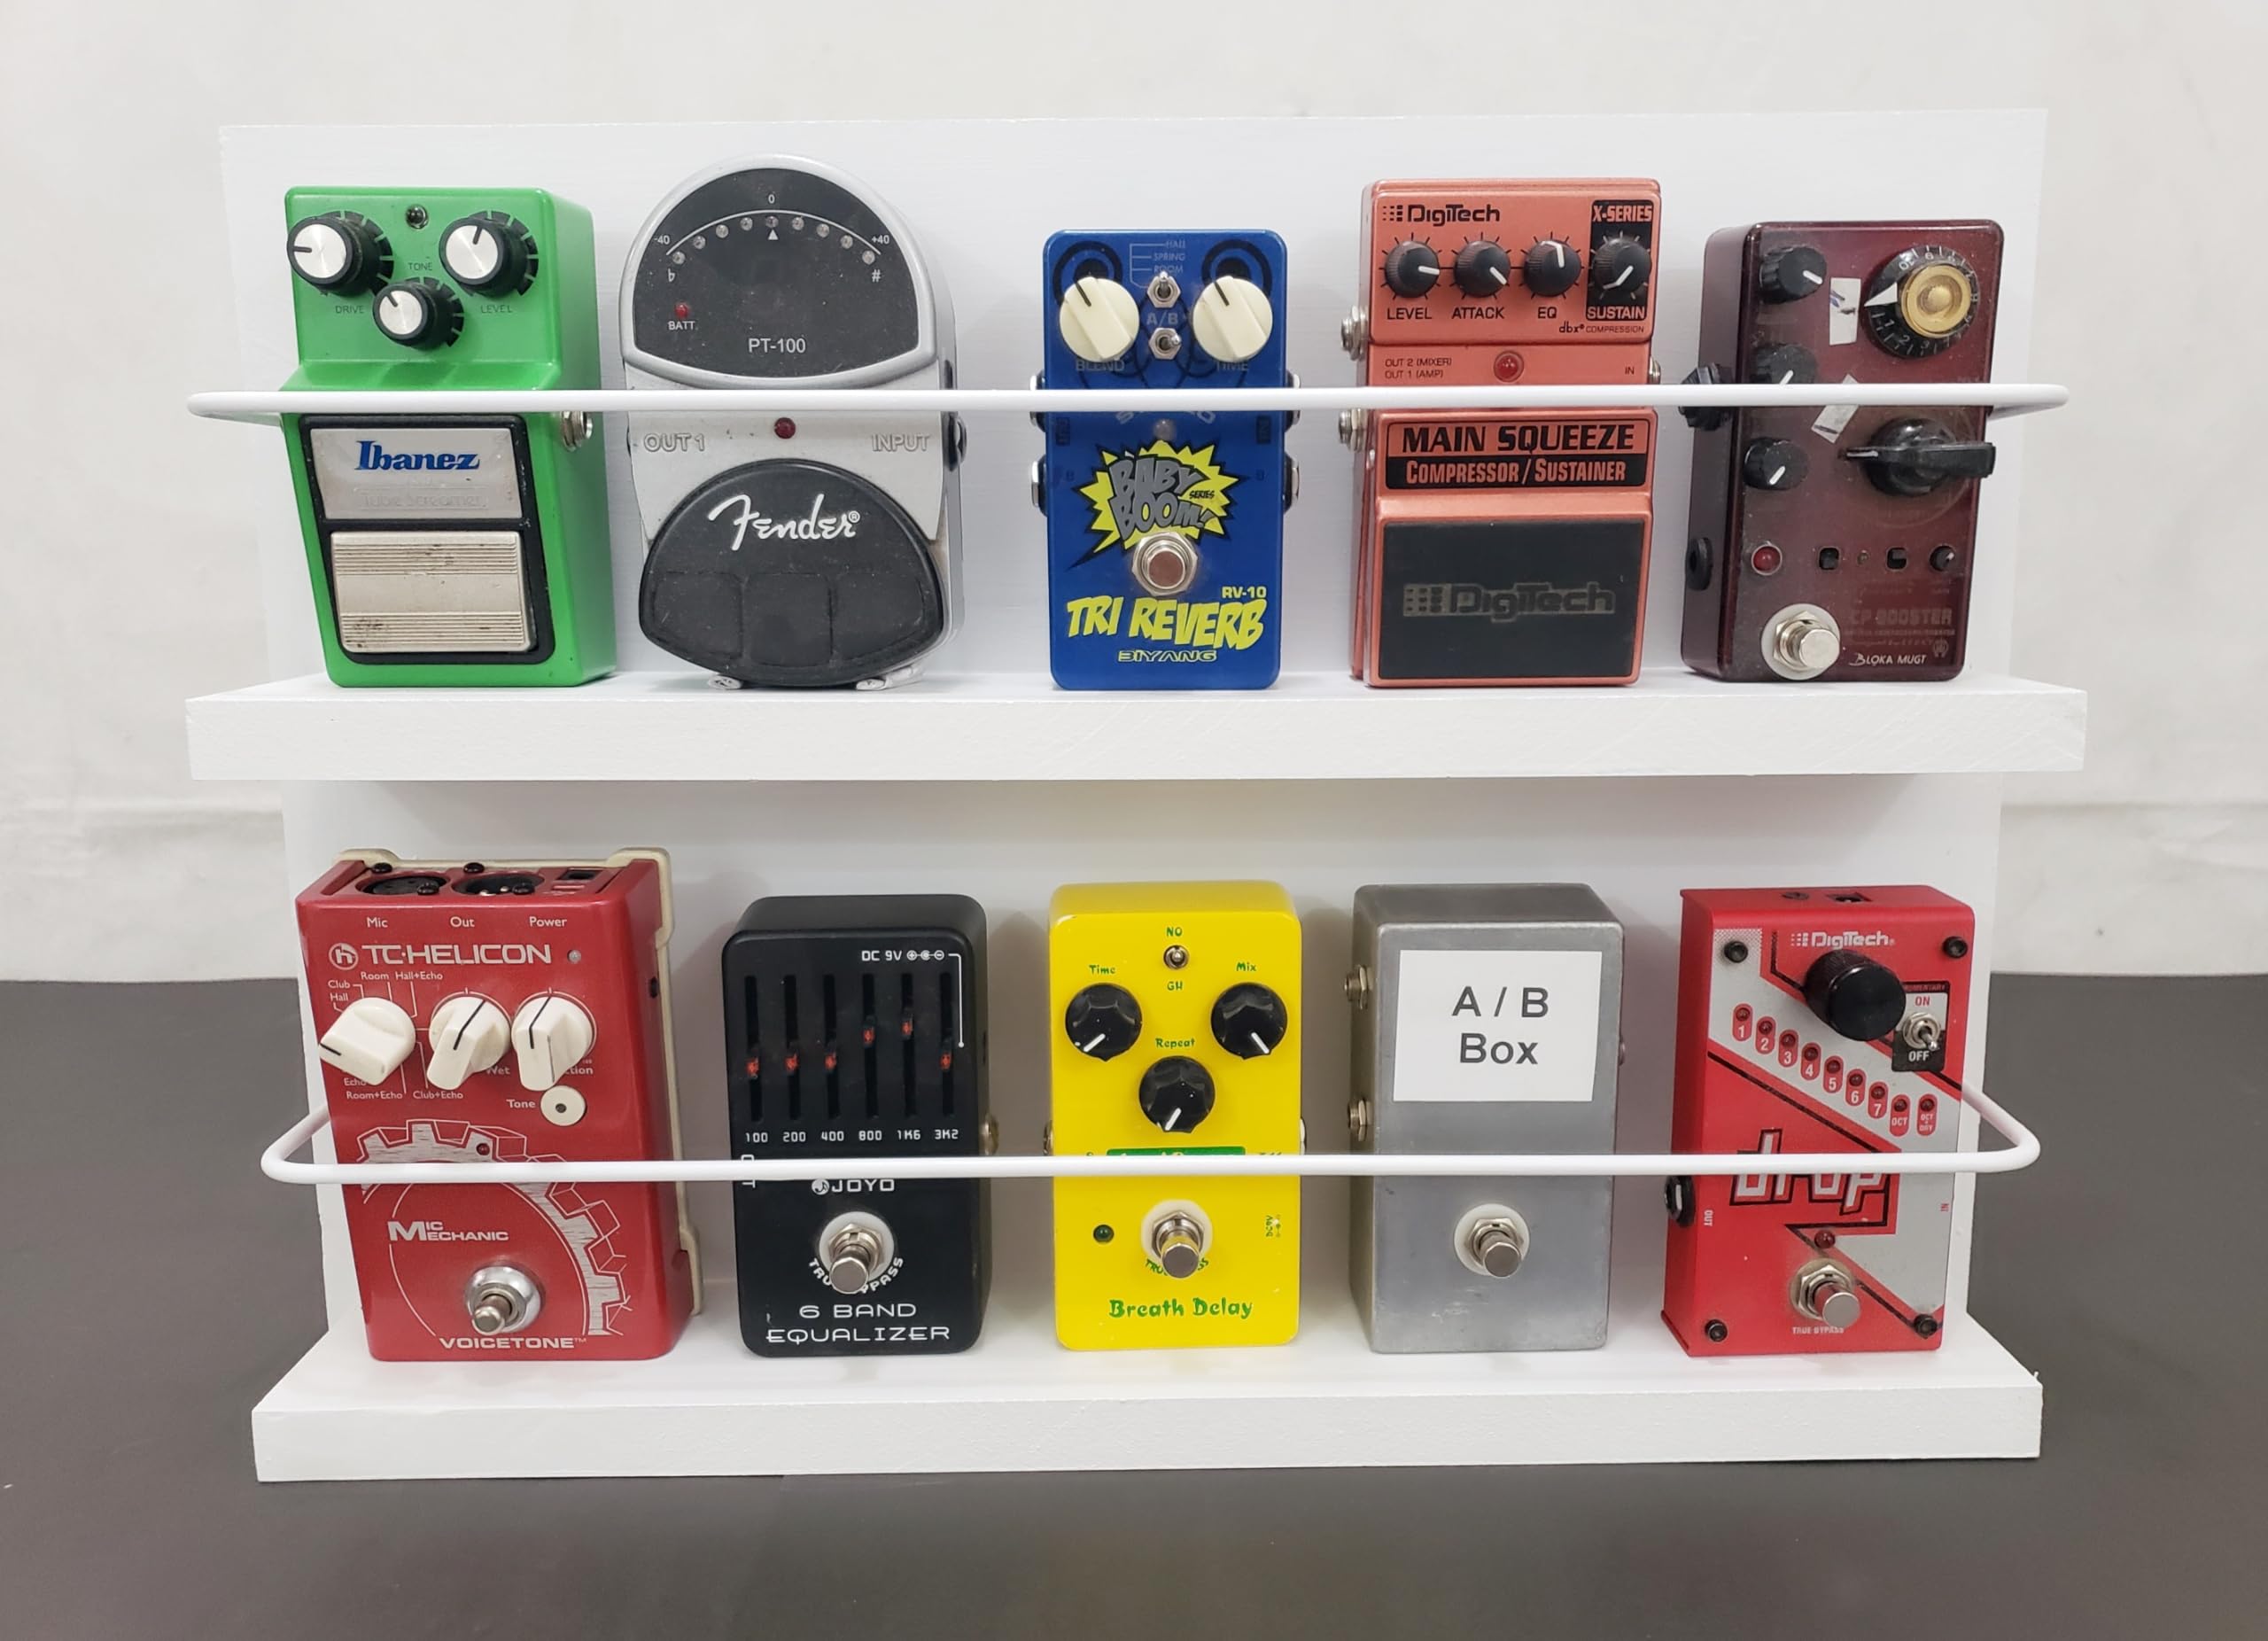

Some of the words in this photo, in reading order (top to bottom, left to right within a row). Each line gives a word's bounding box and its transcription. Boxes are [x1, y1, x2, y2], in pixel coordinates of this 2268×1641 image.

[768, 194, 775, 205] 0
[1407, 205, 1500, 227] DigiTech
[1592, 205, 1653, 222] X-SERIES
[871, 235, 889, 245] +40
[1153, 253, 1185, 261] SPRING
[408, 261, 433, 271] TONE
[335, 305, 365, 315] DRIVE
[481, 305, 513, 314] LEVEL
[1387, 308, 1433, 320] LEVEL
[1451, 307, 1505, 320] ATTACK
[1537, 307, 1557, 320] EQ
[1587, 307, 1645, 319] SUSTAIN
[668, 321, 695, 331] BATT
[1146, 315, 1178, 325] A/B
[1586, 325, 1644, 334] COMPRESSION
[749, 338, 806, 354] PT-100
[1385, 358, 1404, 368] OUT
[1407, 358, 1413, 368] 2
[1417, 357, 1452, 367] (MIXER)
[1384, 369, 1403, 379] OUT
[1408, 369, 1412, 379] 1
[1416, 369, 1443, 379] (AMP)
[1625, 367, 1635, 376] IN
[644, 433, 691, 452] OUT
[695, 433, 705, 451] 1
[872, 433, 930, 452] INPUT
[1402, 426, 1485, 453] MAIN
[1498, 424, 1635, 454] SQUEEZE
[354, 440, 480, 471] Ibanez
[1109, 456, 1208, 495] BABY
[1189, 490, 1216, 500] SERIES
[1222, 587, 1267, 599] RV-10
[1450, 582, 1615, 623] DigiTech
[1067, 595, 1124, 638] TRI
[1129, 597, 1268, 650] REVERB
[1118, 649, 1217, 663] BIYANG
[1897, 654, 1928, 665] MUGT
[366, 916, 388, 928] Mic
[450, 916, 475, 928] Out
[529, 916, 567, 928] Power
[1166, 927, 1183, 937] NO
[862, 951, 880, 961] DC
[885, 951, 903, 961] 9V
[1089, 965, 1116, 975] Time
[1236, 962, 1256, 972] Mix
[361, 971, 389, 981] Room
[395, 971, 444, 981] Hall+Echo
[328, 980, 351, 989] Club
[1167, 981, 1183, 991] GH
[330, 992, 349, 1001] Hall
[1452, 986, 1481, 1017] A
[1494, 986, 1507, 1018] /
[1521, 987, 1549, 1018] B
[1915, 995, 1931, 1007] ON
[1738, 1025, 1745, 1038] 1
[1155, 1038, 1195, 1049] Repeat
[1459, 1033, 1538, 1065] Box
[1760, 1038, 1769, 1050] 2
[1783, 1052, 1792, 1063] 3
[1907, 1050, 1930, 1062] OFF
[1806, 1064, 1814, 1076] 4
[1829, 1077, 1837, 1090] 5
[346, 1090, 403, 1100] Room+Echo
[413, 1090, 463, 1100] Club+Echo
[1851, 1091, 1859, 1103] 6
[507, 1099, 536, 1109] Tone
[1874, 1104, 1882, 1116] 7
[1891, 1116, 1908, 1126] OCT
[745, 1132, 768, 1143] 100
[782, 1132, 806, 1142] 200
[820, 1131, 844, 1142] 400
[858, 1130, 882, 1141] 800
[897, 1130, 921, 1140] 1K6
[935, 1129, 959, 1139] 3K2
[832, 1178, 895, 1193] JOYO
[1704, 1209, 1713, 1226] OUT
[387, 1220, 509, 1240] MECHANIC
[809, 1257, 833, 1287] TRU
[799, 1305, 820, 1318] 6
[834, 1303, 917, 1318] BAND
[1109, 1299, 1184, 1318] Breath
[1192, 1297, 1254, 1319] Delay
[766, 1326, 950, 1345] EQUALIZER
